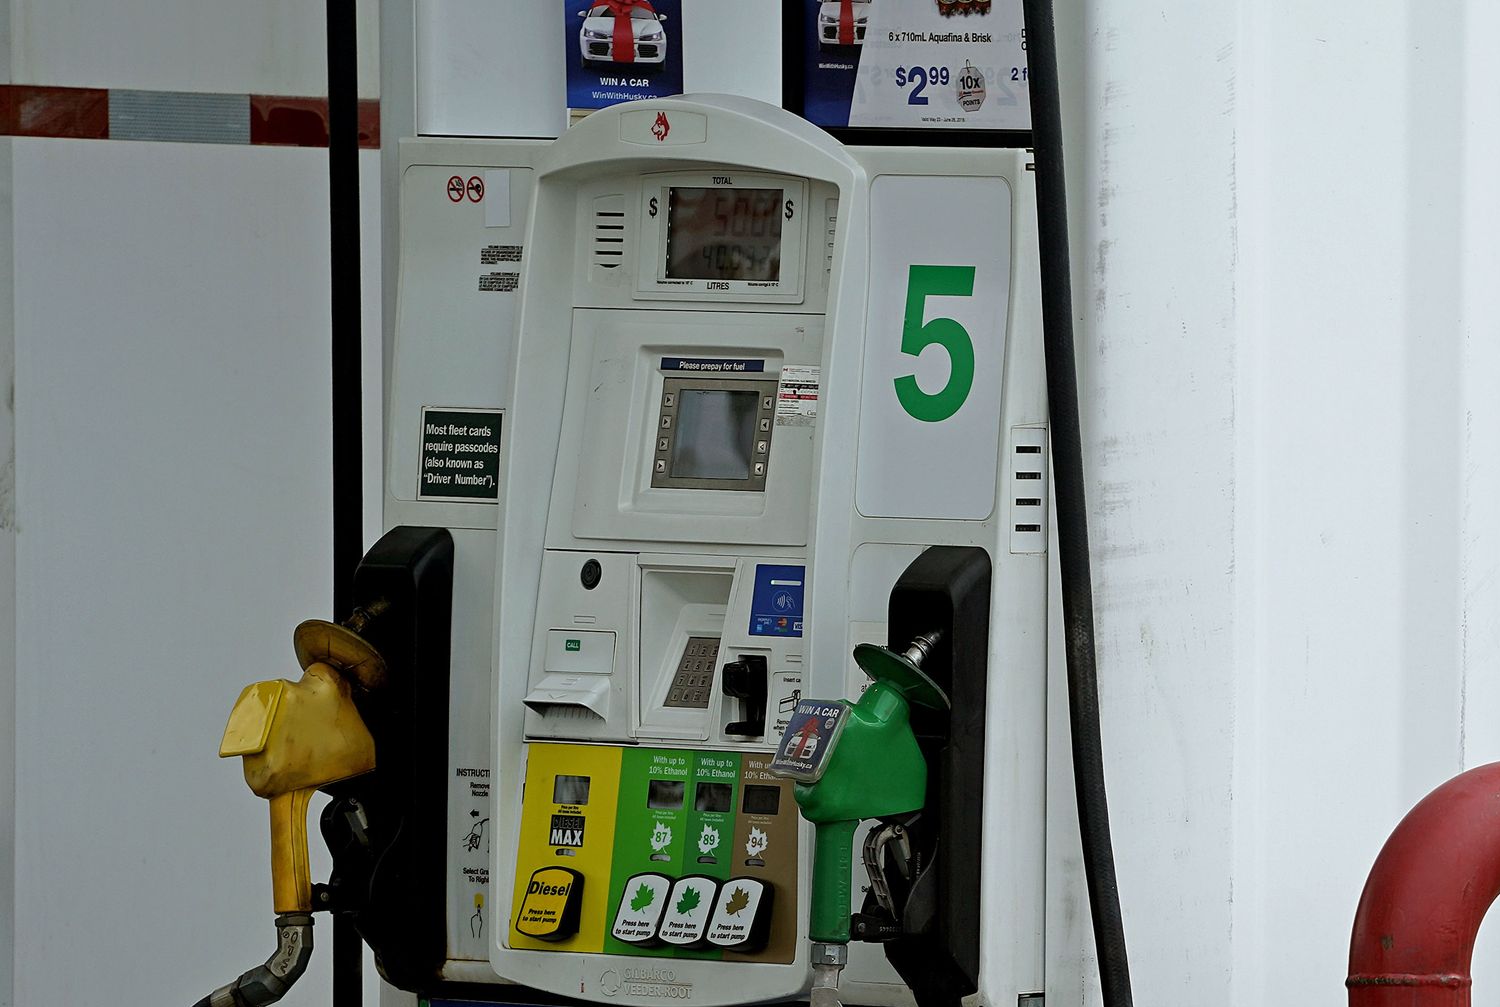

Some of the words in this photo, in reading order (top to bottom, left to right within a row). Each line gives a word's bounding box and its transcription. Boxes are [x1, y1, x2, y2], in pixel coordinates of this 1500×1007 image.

[889, 32, 893, 41] 6
[902, 32, 926, 42] 710mL
[928, 32, 962, 44] Aquafina
[964, 33, 970, 42] &
[972, 33, 992, 42] Brisk
[600, 77, 618, 86] WIN
[629, 79, 649, 87] CAR
[960, 76, 981, 89] 10x
[962, 99, 980, 107] POINTS
[712, 177, 732, 185] TOTAL
[649, 197, 658, 218] $
[785, 199, 794, 221] $
[706, 282, 729, 290] LITRES
[894, 265, 976, 422] 5
[679, 361, 700, 370] Please
[701, 363, 722, 371] prepay
[723, 362, 732, 370] for
[733, 363, 745, 371] fuel
[426, 424, 447, 435] Most
[449, 424, 467, 436] fleet
[469, 426, 491, 437] cards
[425, 441, 453, 453] require
[455, 442, 498, 454] passcodes
[425, 456, 444, 469] (also
[445, 457, 472, 468] known
[474, 461, 484, 469] as
[799, 705, 814, 714] WIN
[814, 707, 821, 716] A
[821, 708, 839, 718] CAR
[653, 756, 668, 765] With
[678, 757, 685, 765] to
[701, 758, 715, 767] With
[716, 760, 724, 768] up
[726, 759, 733, 767] to
[749, 761, 763, 769] With
[456, 768, 490, 777] INSTRUCTI
[649, 766, 663, 774] 10%
[664, 767, 688, 776] Ethanol
[696, 769, 710, 777] 10%
[711, 768, 736, 778] Ethanol
[472, 789, 488, 797] Nozzle
[553, 817, 583, 830] DIESEL
[550, 830, 582, 846] MAX
[655, 832, 668, 843] 87
[703, 834, 715, 845] 89
[751, 837, 763, 848] 94
[463, 867, 478, 875] Select
[528, 880, 571, 896] Diesel
[528, 908, 543, 916] Press
[529, 915, 542, 923] start
[622, 919, 637, 927] Press
[668, 921, 683, 929] Press
[685, 922, 696, 930] here
[624, 968, 676, 981] GILBARCO
[624, 984, 692, 999] VEEDER-ROOT
